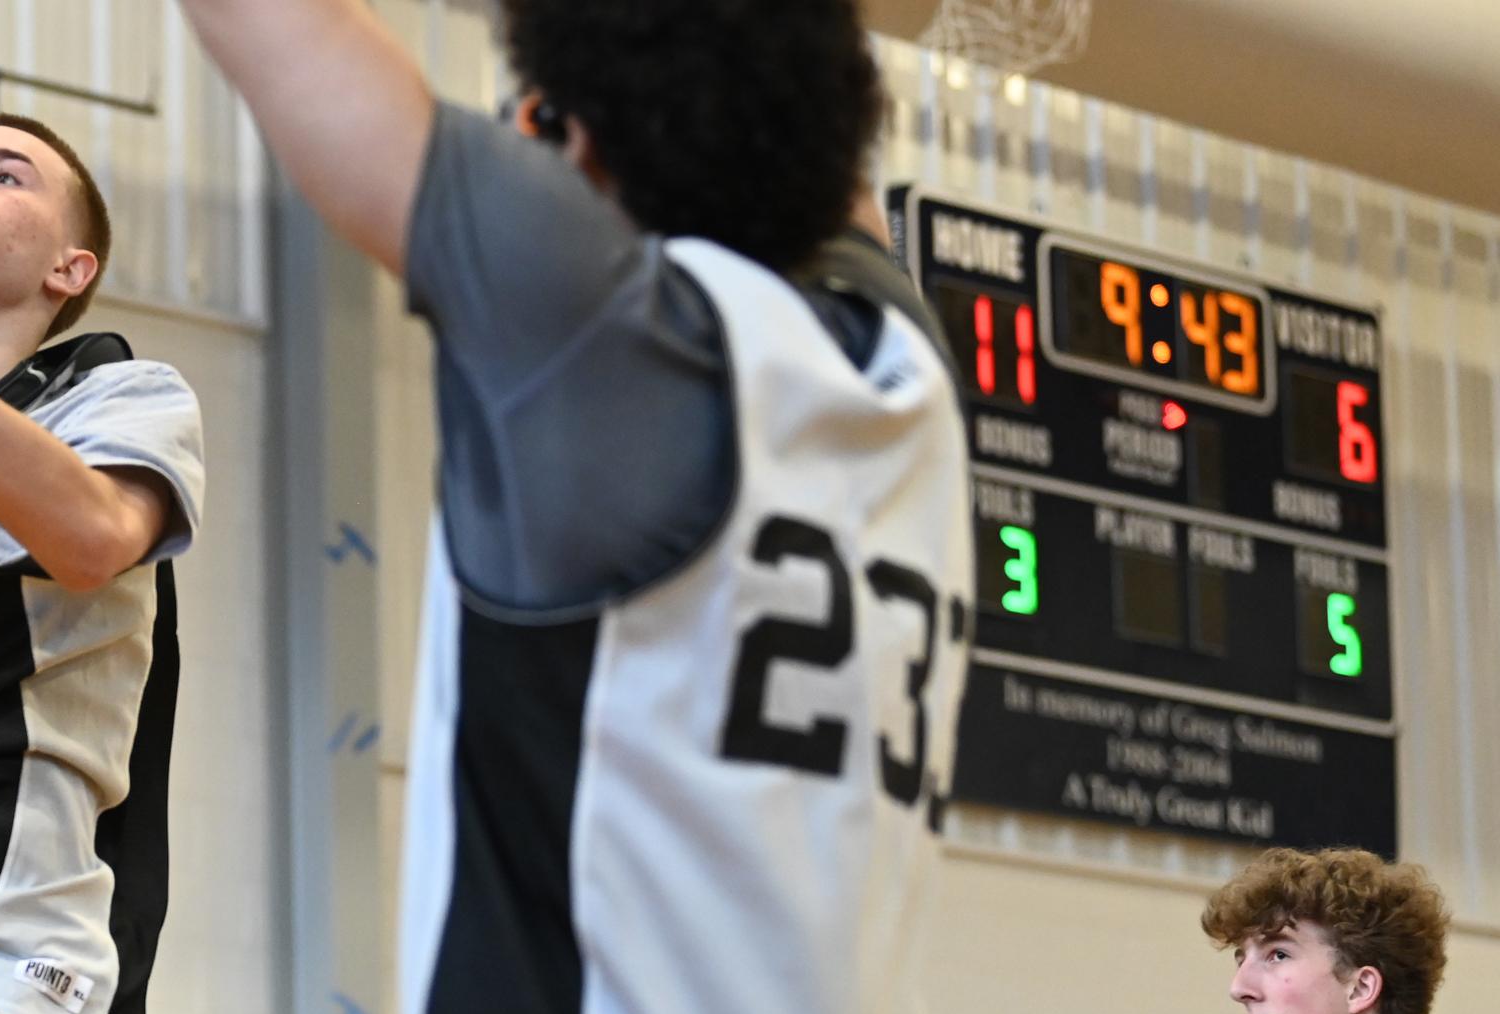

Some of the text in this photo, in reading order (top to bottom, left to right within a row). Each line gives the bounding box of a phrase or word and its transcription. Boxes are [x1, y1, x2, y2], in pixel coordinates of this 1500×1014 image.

[932, 212, 1025, 283] HOME
[974, 293, 1037, 405] 11
[1100, 260, 1257, 395] 9:43
[1275, 301, 1377, 372] VISITOR
[1337, 380, 1377, 484] 6
[975, 482, 1034, 527] OULS
[1000, 525, 1039, 616] 3
[719, 512, 966, 834] 23
[1326, 591, 1363, 678] 5
